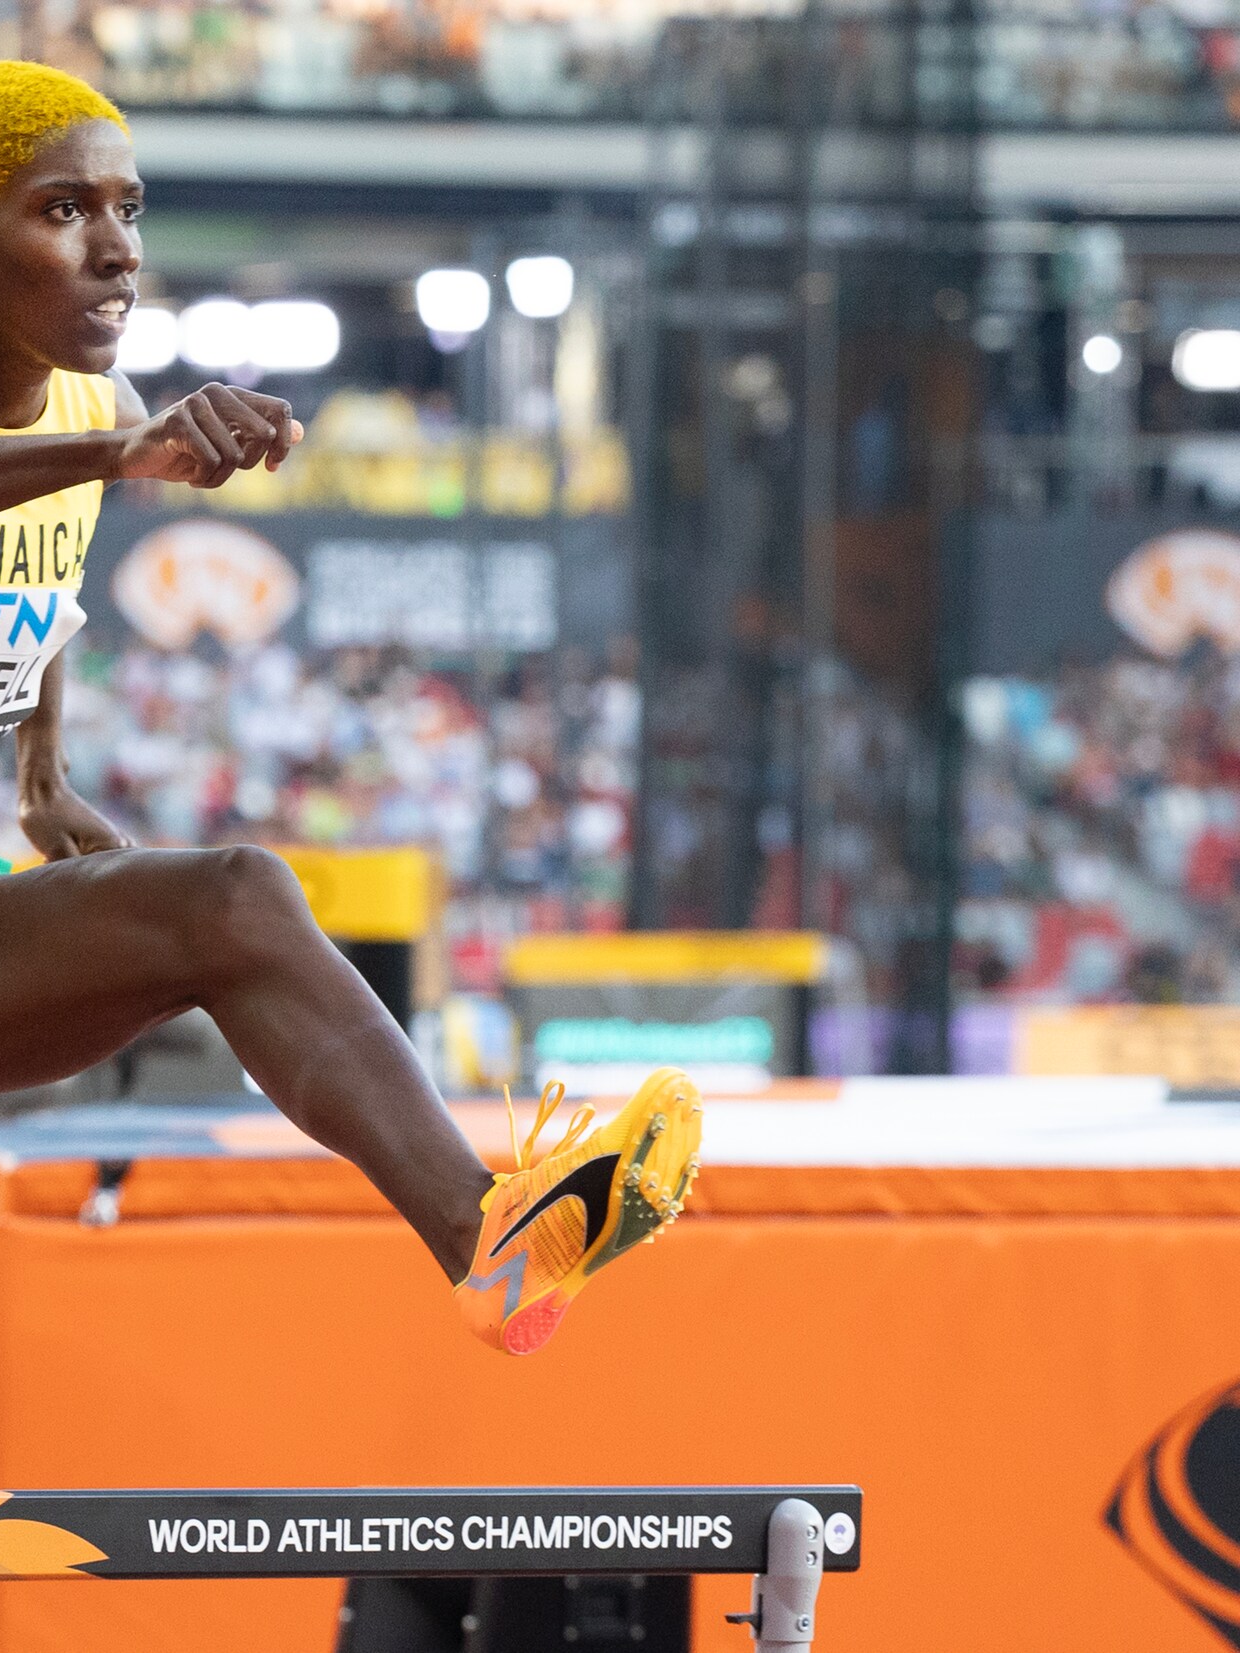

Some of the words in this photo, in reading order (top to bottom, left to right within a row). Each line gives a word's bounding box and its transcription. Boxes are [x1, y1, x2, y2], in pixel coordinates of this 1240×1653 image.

[148, 1518, 271, 1553] WORLD
[277, 1516, 455, 1552] ATHLETICS
[461, 1514, 733, 1550] CHAMPIONSHIPS
